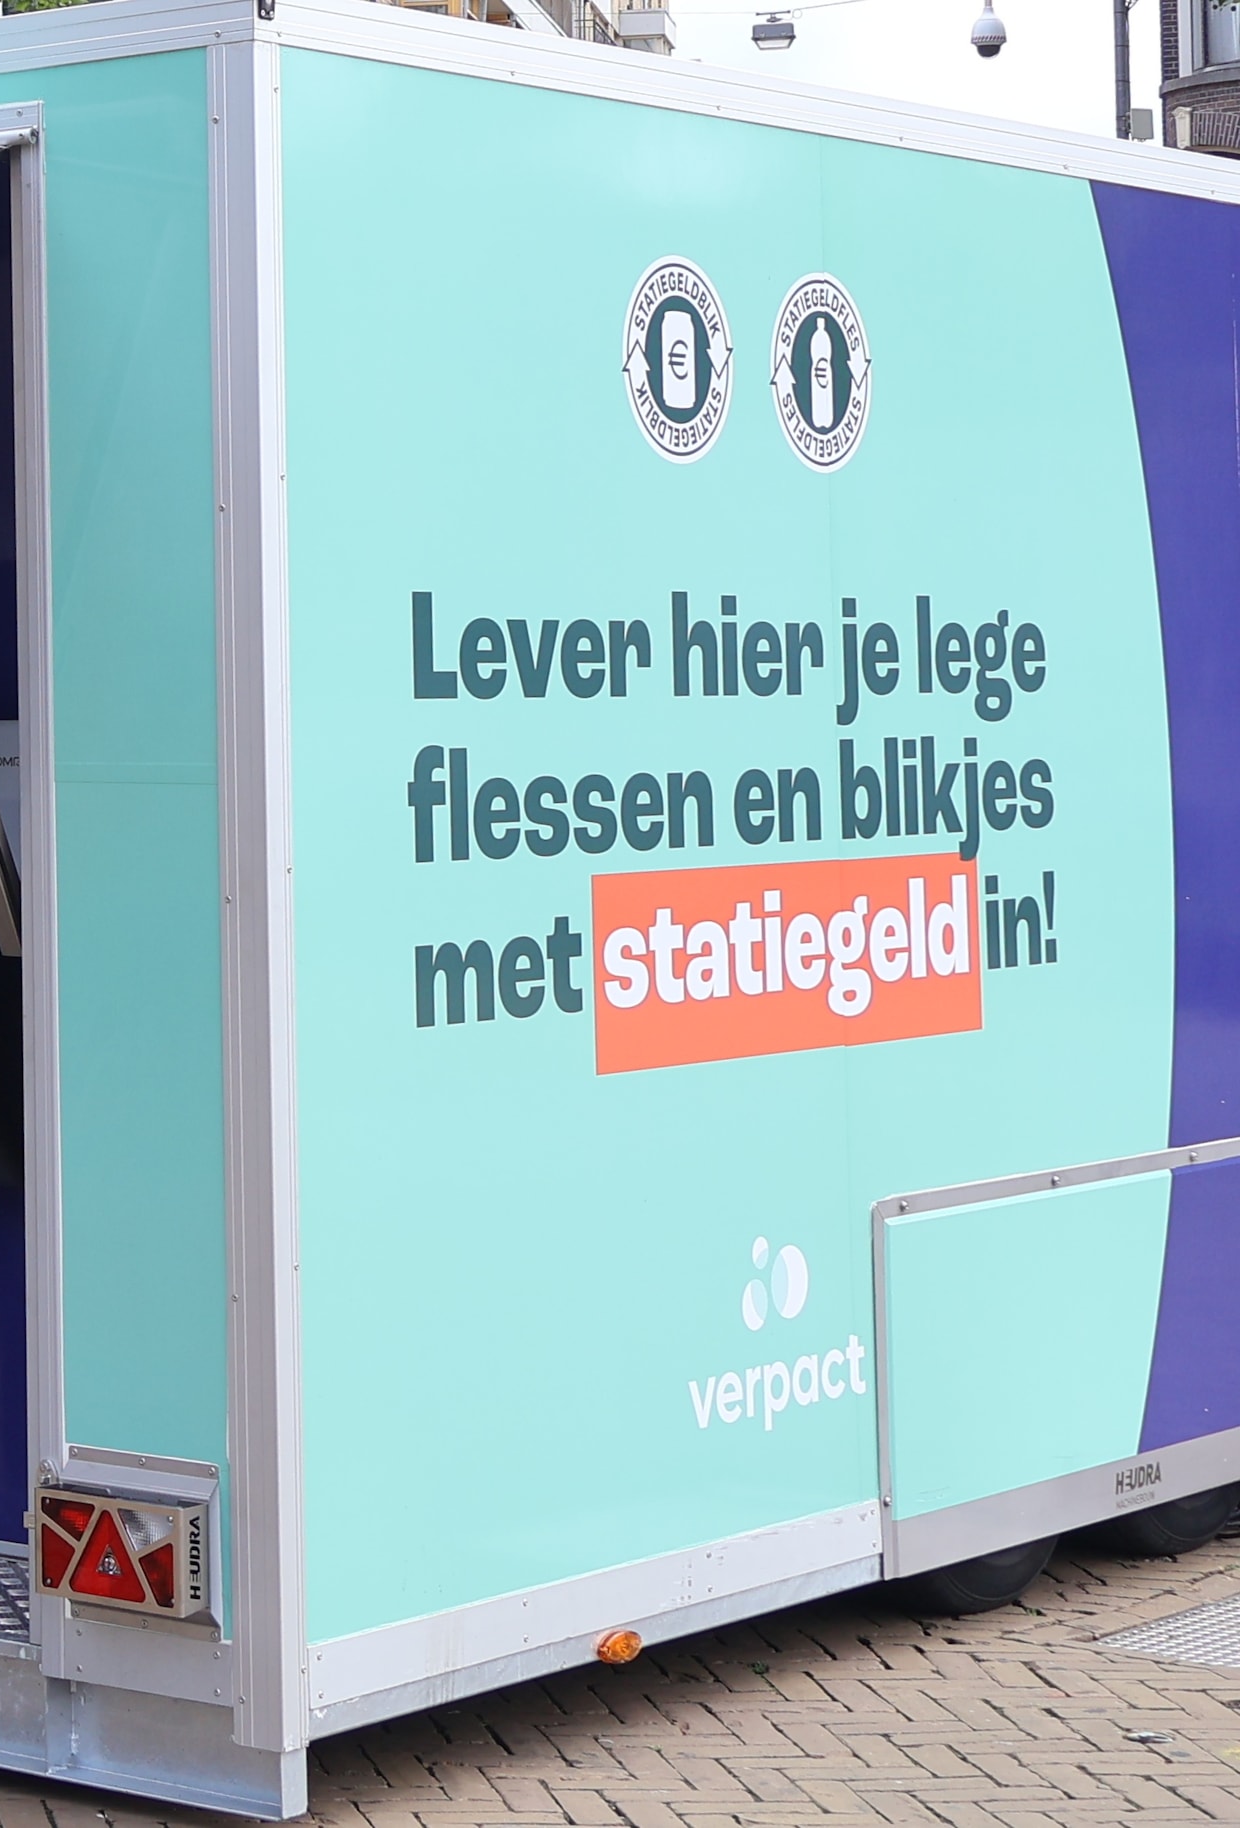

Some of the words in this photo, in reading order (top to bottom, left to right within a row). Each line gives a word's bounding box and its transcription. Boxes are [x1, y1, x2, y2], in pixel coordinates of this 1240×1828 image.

[634, 271, 721, 339] STATIEGELDBLIK
[781, 287, 860, 352] STATIEGELDFLES
[635, 381, 722, 448] STATIEGELDBLIK
[782, 392, 862, 458] STATIEGELDFLES
[411, 590, 652, 700] Lever
[671, 590, 824, 697] hier
[836, 597, 900, 725] je
[916, 595, 1047, 722] lege
[407, 745, 714, 863] flessen
[734, 767, 822, 845] en
[839, 735, 1054, 861] blikjes
[415, 915, 584, 1028] met
[603, 873, 971, 1018] statiegeld
[985, 870, 1058, 971] in!
[688, 1333, 867, 1432] verpact
[1115, 1461, 1162, 1495] HEUDRA
[189, 1515, 201, 1600] HEUDRA
